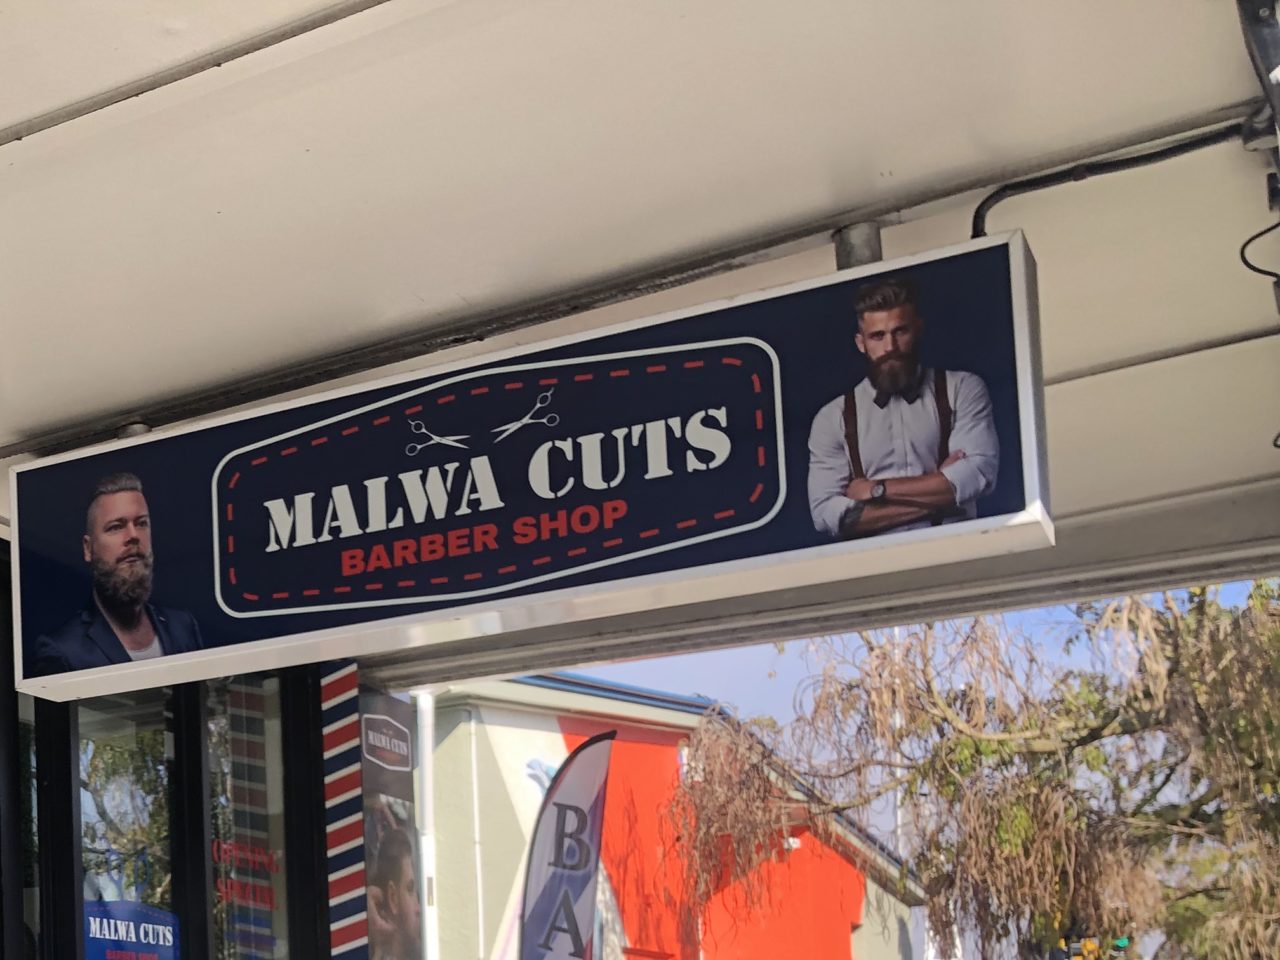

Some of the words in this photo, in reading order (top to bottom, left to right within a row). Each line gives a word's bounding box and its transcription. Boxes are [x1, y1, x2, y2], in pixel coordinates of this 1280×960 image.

[262, 453, 505, 554] MALWA
[528, 405, 733, 500] CUTS
[340, 522, 498, 577] BARBER
[512, 499, 630, 546] SHOP
[88, 916, 137, 943] MALWA
[140, 923, 174, 947] CUTS
